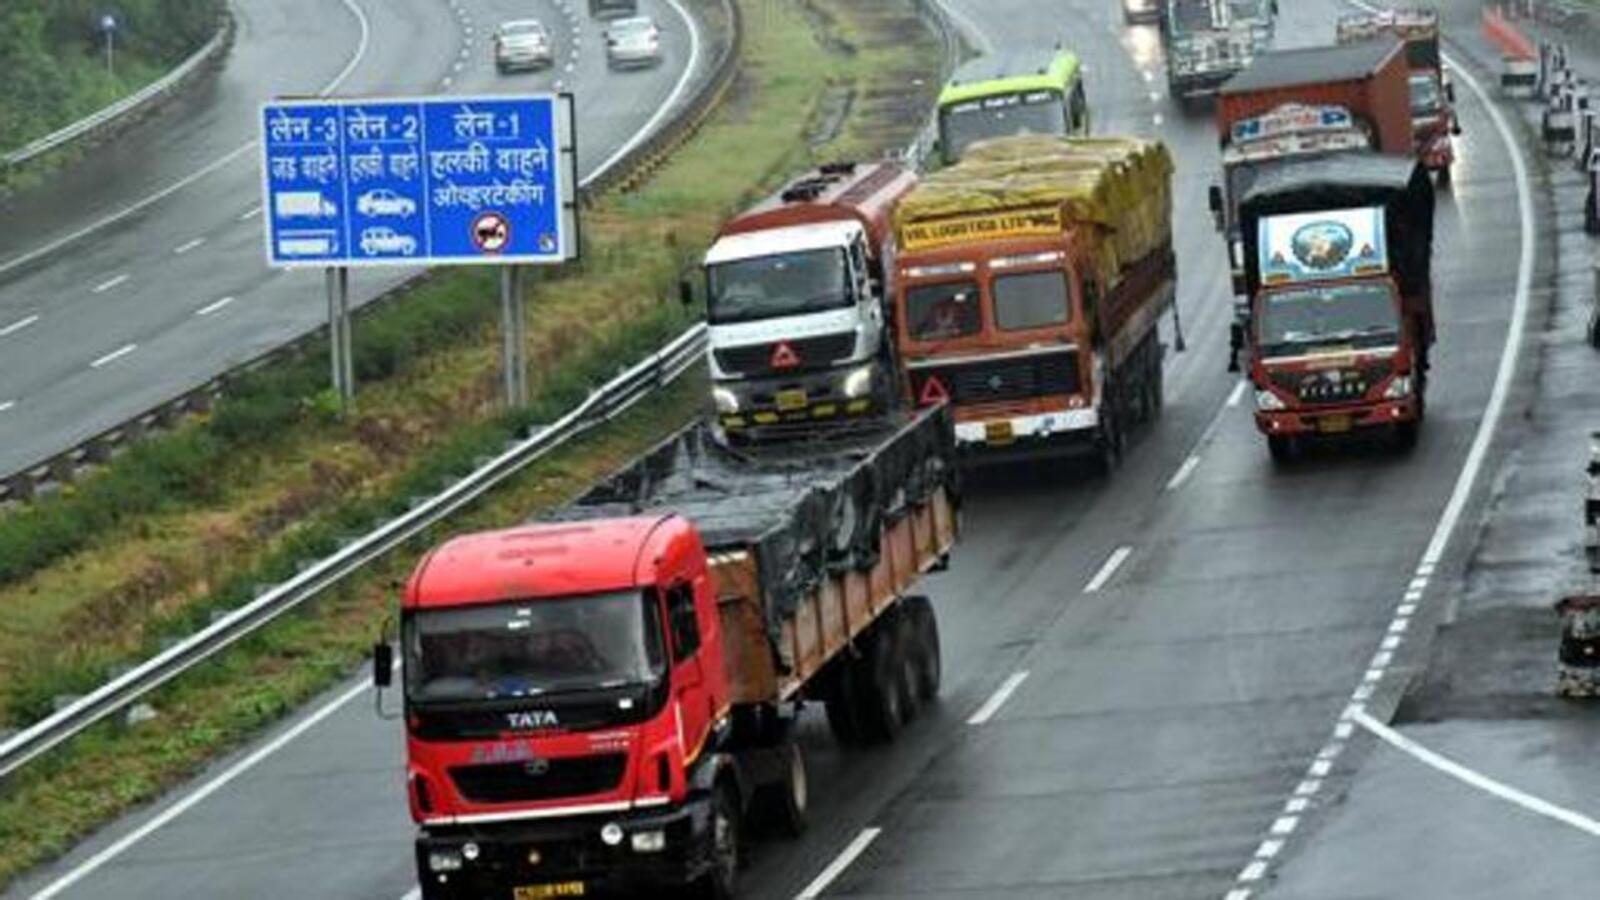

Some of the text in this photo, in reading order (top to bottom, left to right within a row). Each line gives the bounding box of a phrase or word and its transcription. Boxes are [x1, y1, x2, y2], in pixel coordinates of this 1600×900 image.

[430, 138, 549, 179] हलकी वाहने
[507, 710, 559, 728] TATA
